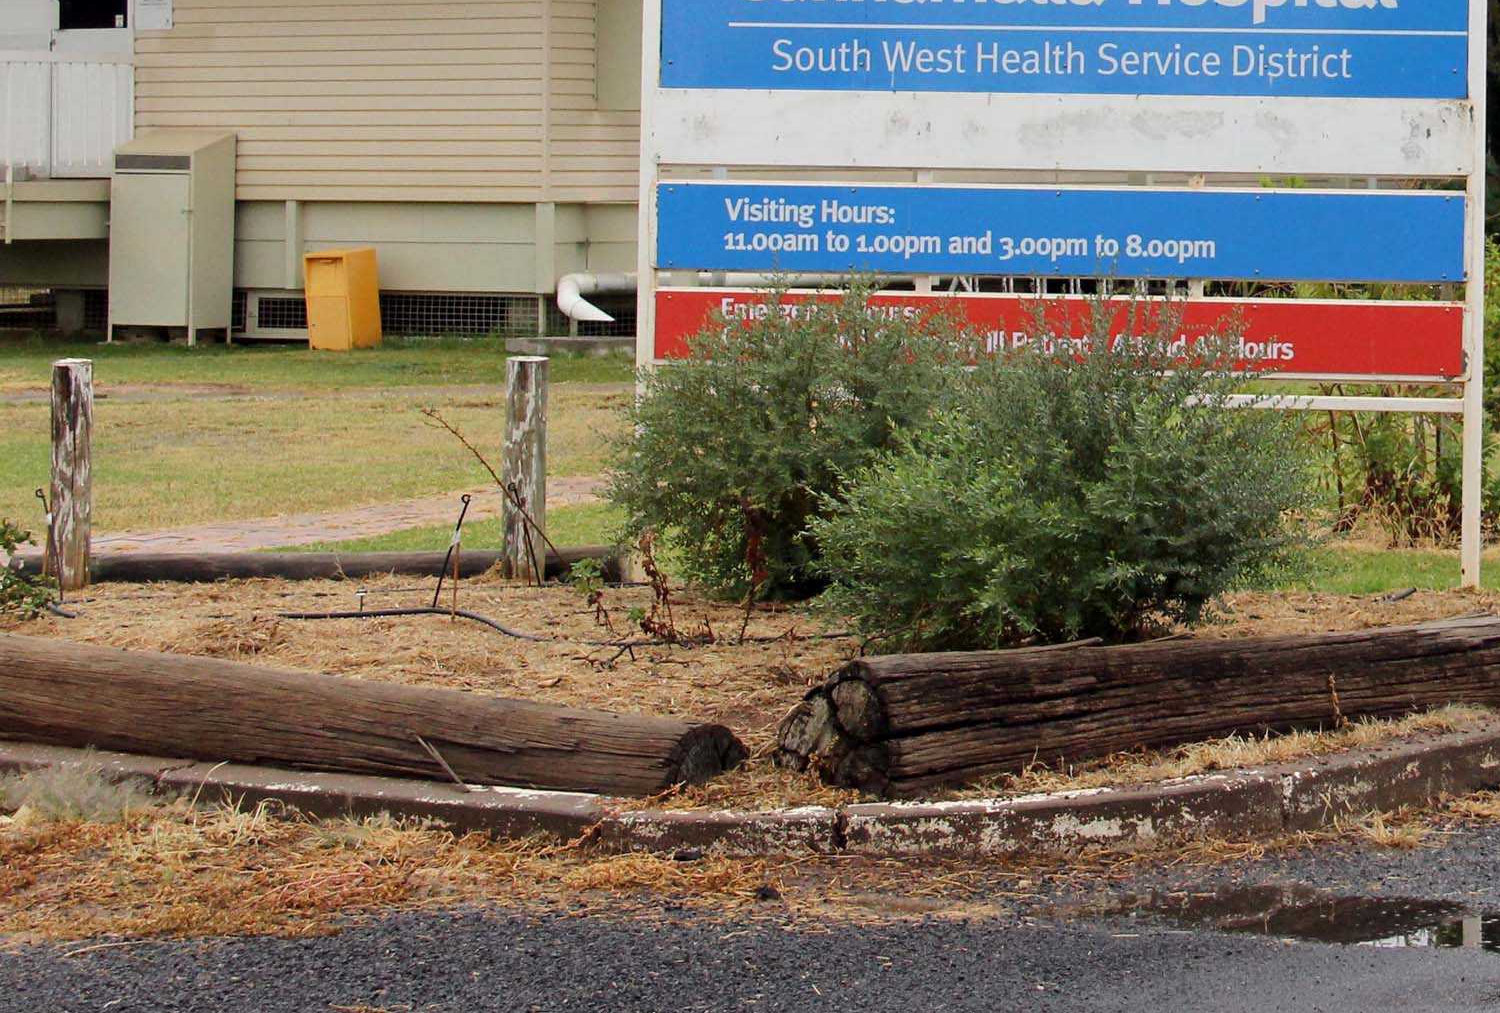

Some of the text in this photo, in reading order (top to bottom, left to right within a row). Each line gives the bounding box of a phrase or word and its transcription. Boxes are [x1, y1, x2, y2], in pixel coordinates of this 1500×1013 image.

[772, 38, 1352, 78] South West Health Service District
[725, 197, 896, 226] Visiting Hours:
[723, 230, 1216, 264] 11.00am to 1.00pm and 3.00pm to 8.00pm
